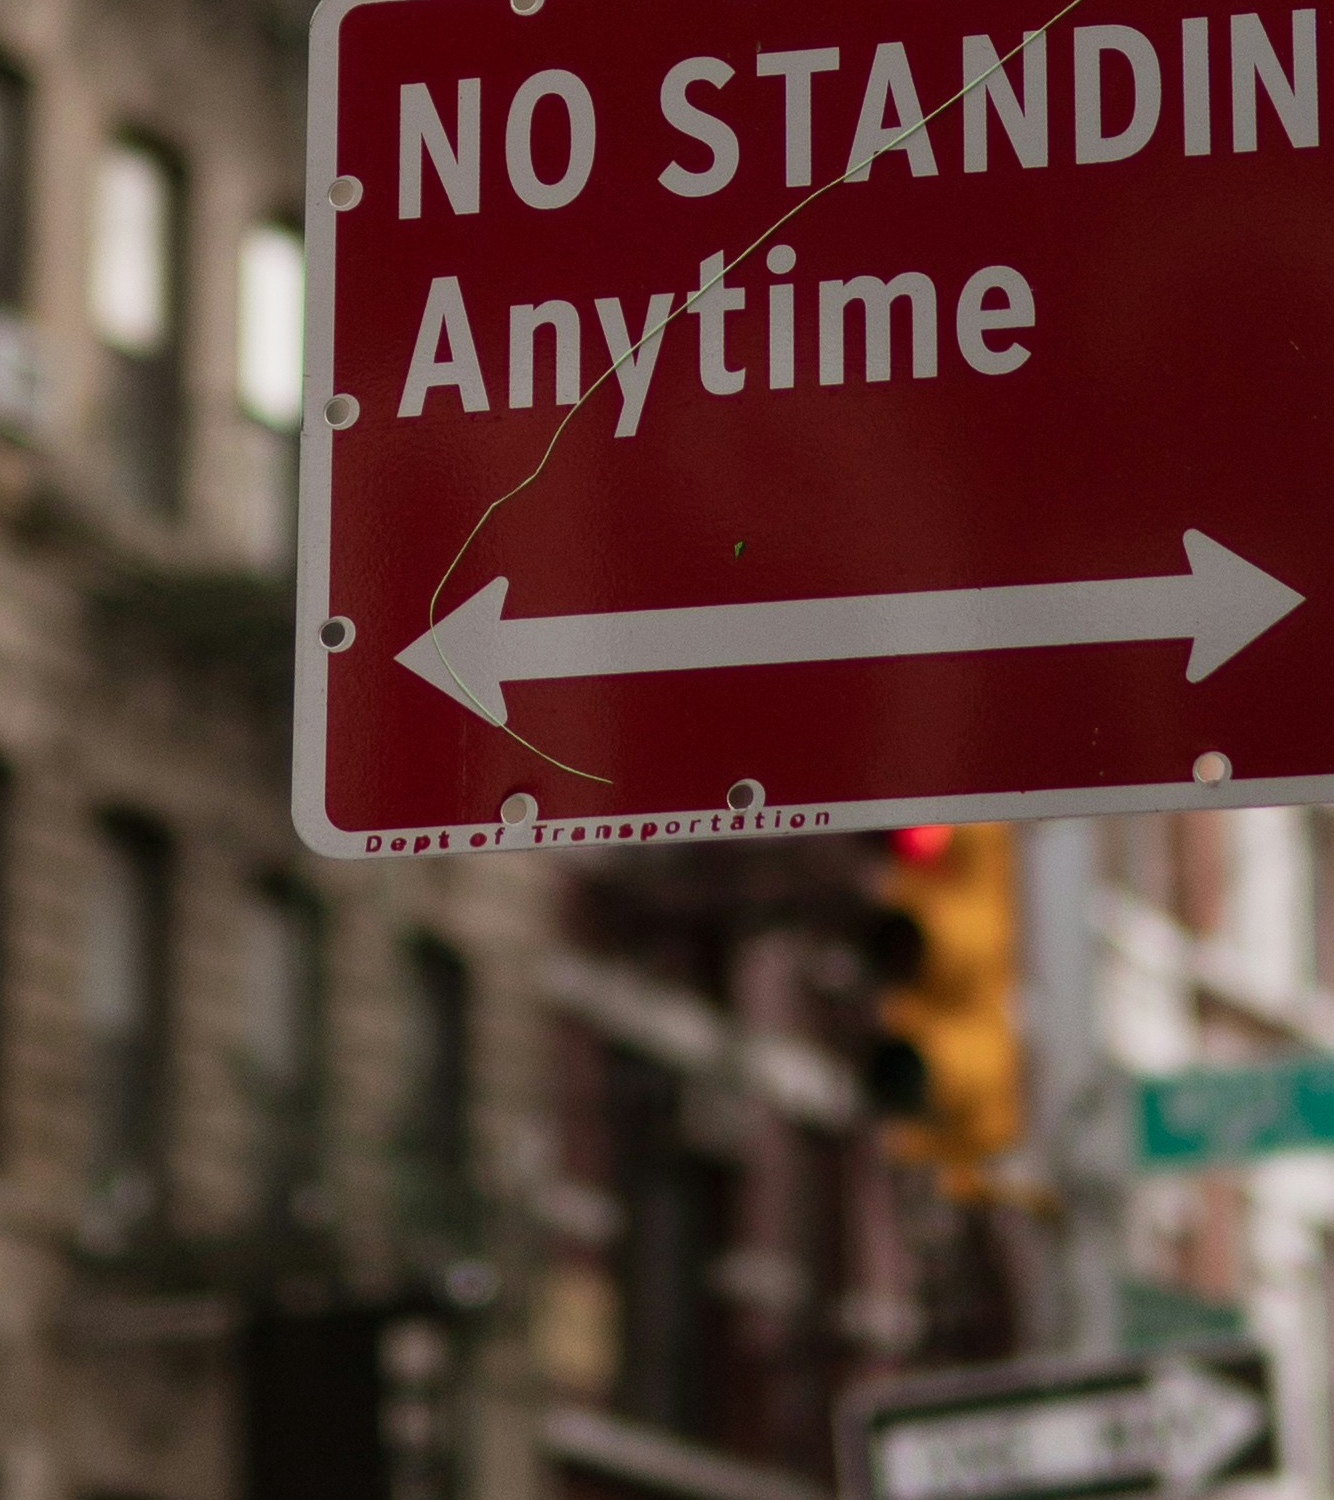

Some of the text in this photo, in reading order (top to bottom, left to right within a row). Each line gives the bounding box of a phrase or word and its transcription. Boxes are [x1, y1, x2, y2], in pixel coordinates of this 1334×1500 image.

[398, 69, 597, 220] NO
[397, 244, 1037, 438] Anytime
[365, 809, 830, 854] Dept of Transportation
